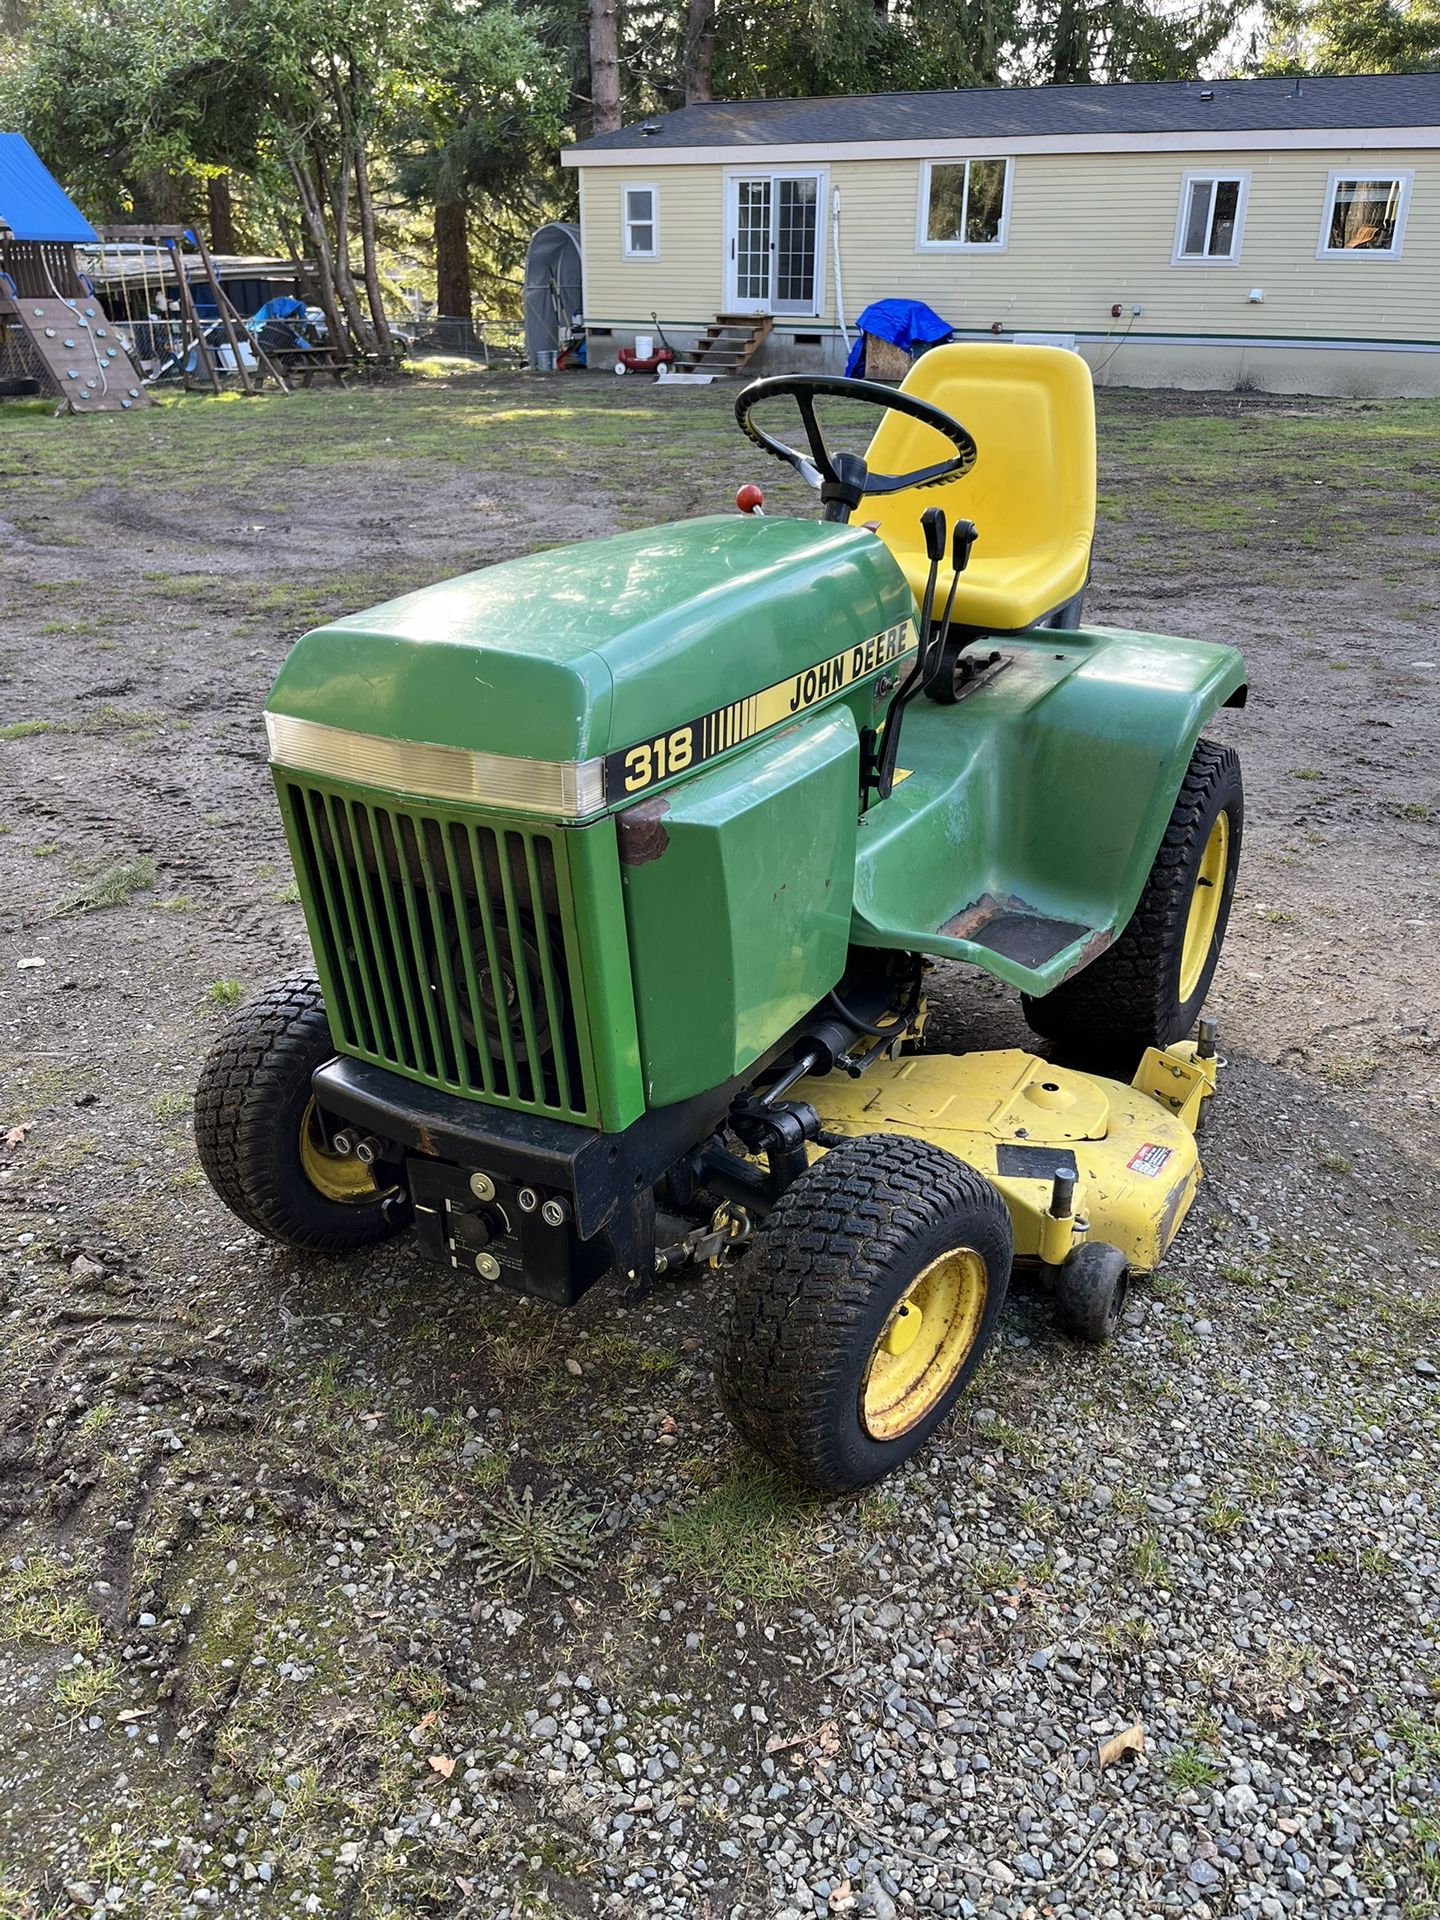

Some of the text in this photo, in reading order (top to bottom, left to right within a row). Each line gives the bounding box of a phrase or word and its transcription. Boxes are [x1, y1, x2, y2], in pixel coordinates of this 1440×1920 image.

[790, 622, 907, 711] JOHN DEERE
[624, 727, 693, 792] 318
